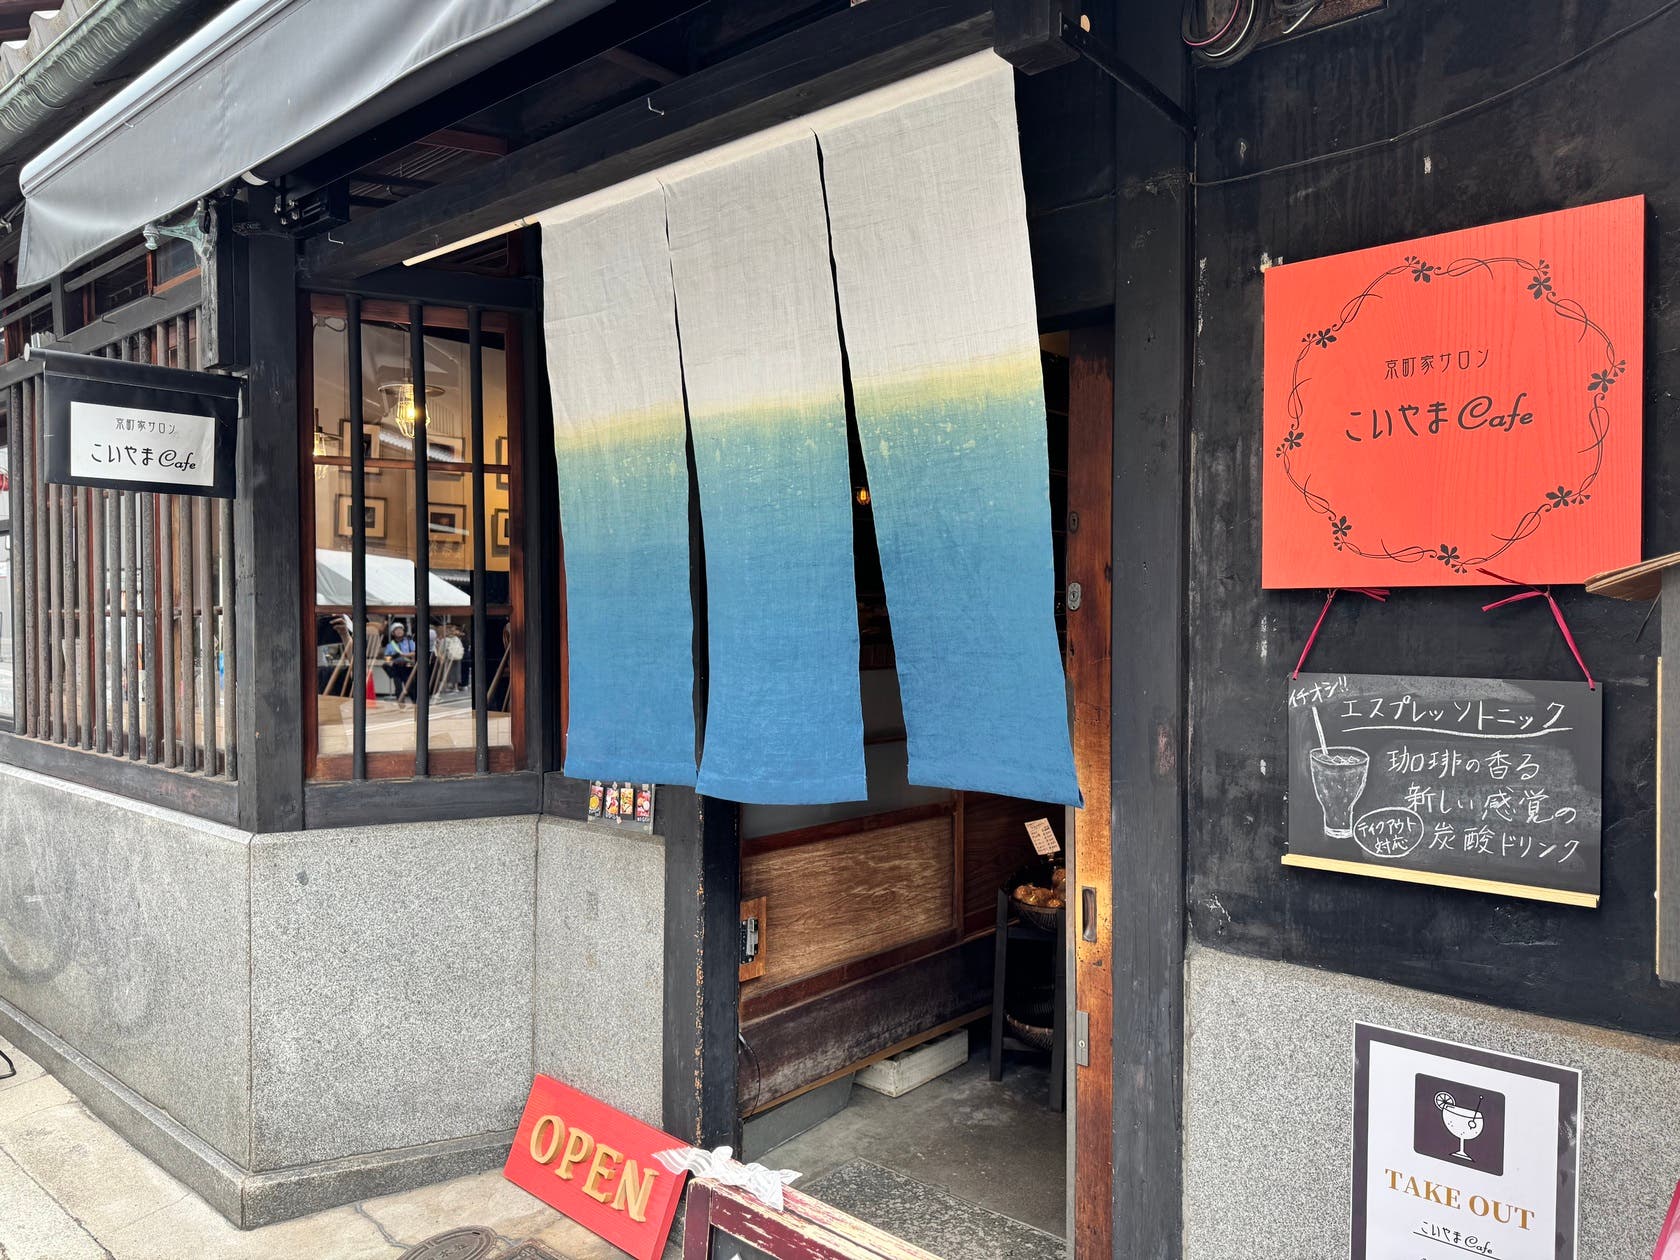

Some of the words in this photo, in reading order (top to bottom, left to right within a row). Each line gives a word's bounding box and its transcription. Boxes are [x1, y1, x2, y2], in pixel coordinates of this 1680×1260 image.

[1384, 348, 1489, 380] 京町家サロン
[115, 417, 176, 435] 京町家サロン
[1340, 695, 1566, 731] エスプレッソトニック
[1387, 745, 1540, 781] 珈琲の香る
[1404, 782, 1576, 825] 新しい感覚の
[1374, 834, 1409, 854] 対応
[1428, 822, 1580, 863] 炭酸ドリンク
[529, 1114, 660, 1223] OPEN
[1384, 1168, 1461, 1210] TAKE
[1469, 1195, 1535, 1231] OUT
